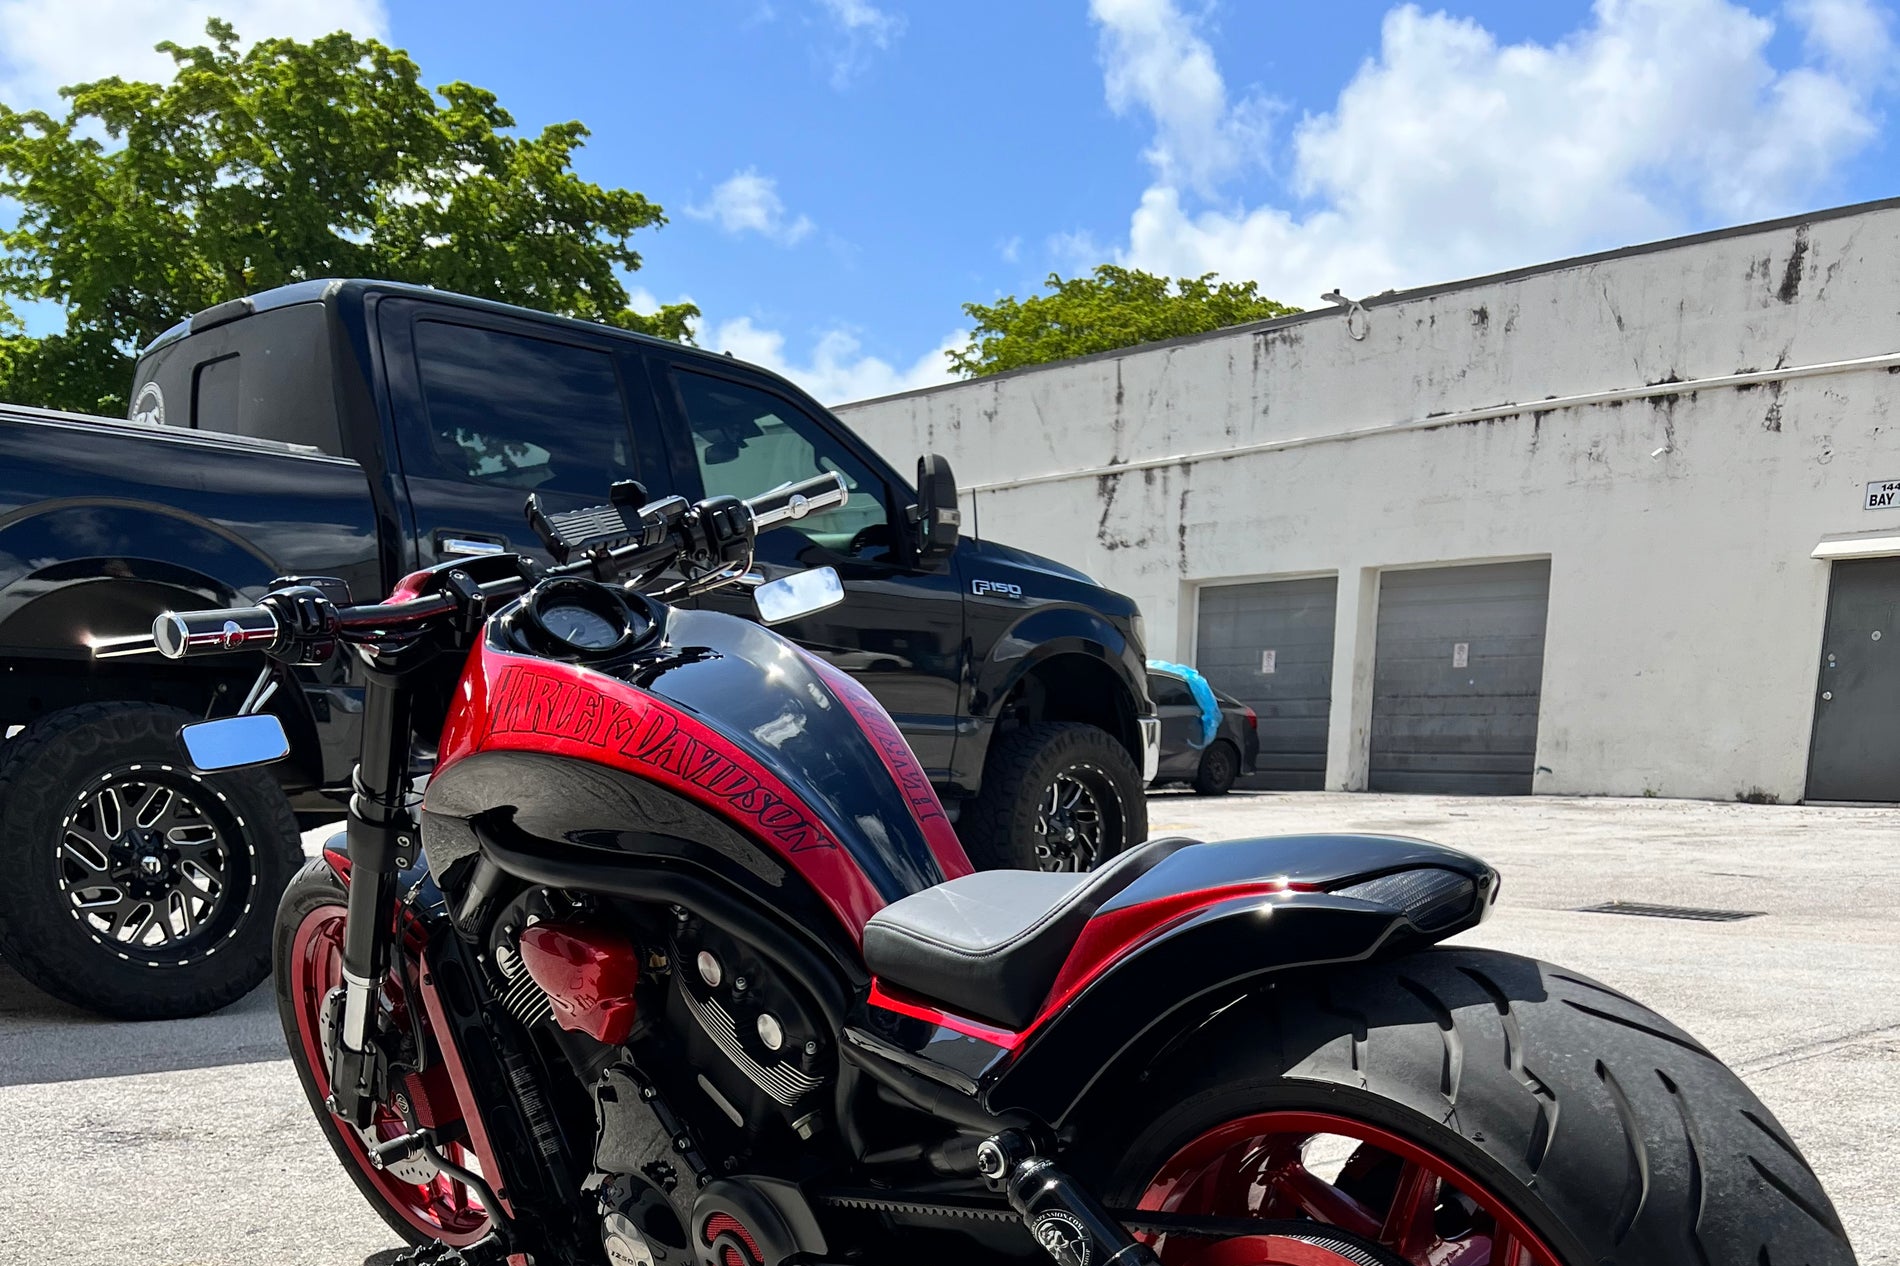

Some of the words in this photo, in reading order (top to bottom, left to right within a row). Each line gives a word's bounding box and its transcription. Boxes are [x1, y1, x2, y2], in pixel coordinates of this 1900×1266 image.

[1869, 493, 1895, 506] BAY
[972, 580, 1021, 595] F150
[490, 664, 632, 747] HARLEY
[619, 702, 837, 853] DAVIDSON
[611, 1250, 634, 1265] 1250
